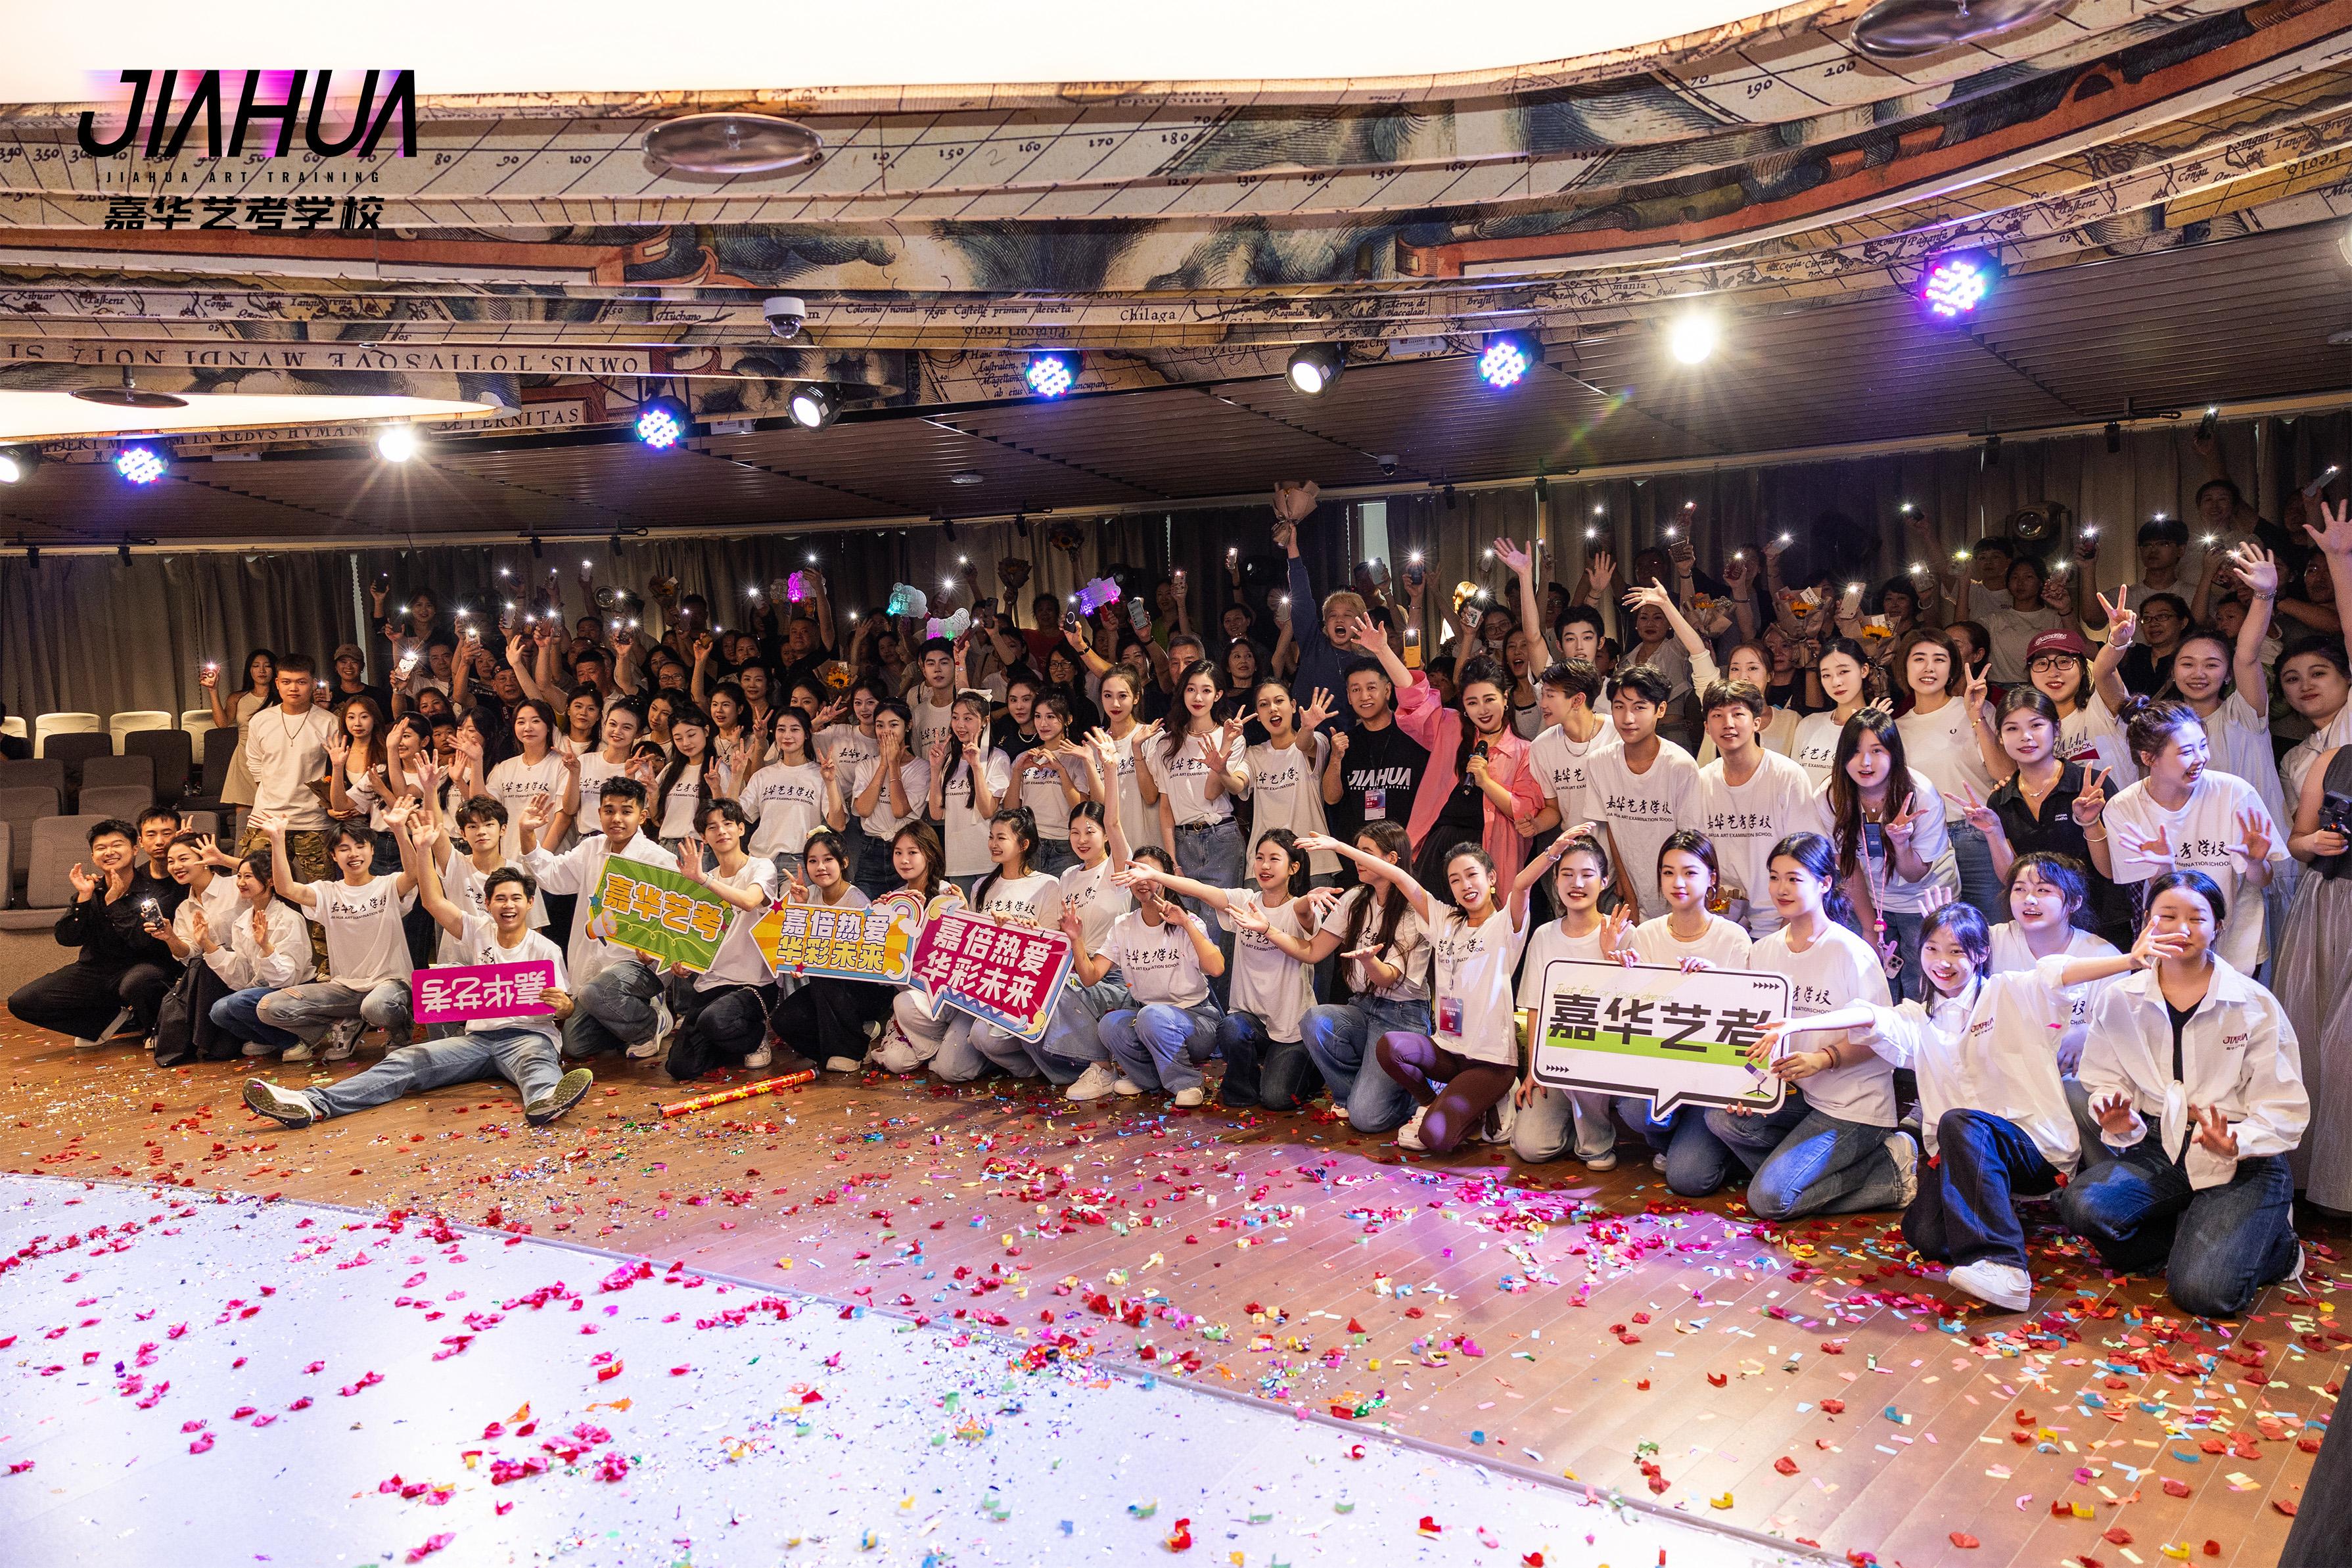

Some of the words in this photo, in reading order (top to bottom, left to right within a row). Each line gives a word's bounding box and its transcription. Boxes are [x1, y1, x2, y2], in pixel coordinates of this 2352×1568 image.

[1347, 766, 1412, 788] JIAHUA
[1606, 795, 1672, 816] 嘉华艺考学校
[603, 874, 724, 940] 嘉华艺考
[783, 908, 890, 944] 嘉倍热爱
[777, 935, 887, 971] 华彩未来
[931, 917, 1053, 977] 嘉倍热爱
[421, 970, 547, 1013] 嘉华艺考
[921, 948, 1039, 1007] 华彩未来
[1548, 993, 1772, 1059] 嘉华艺考
